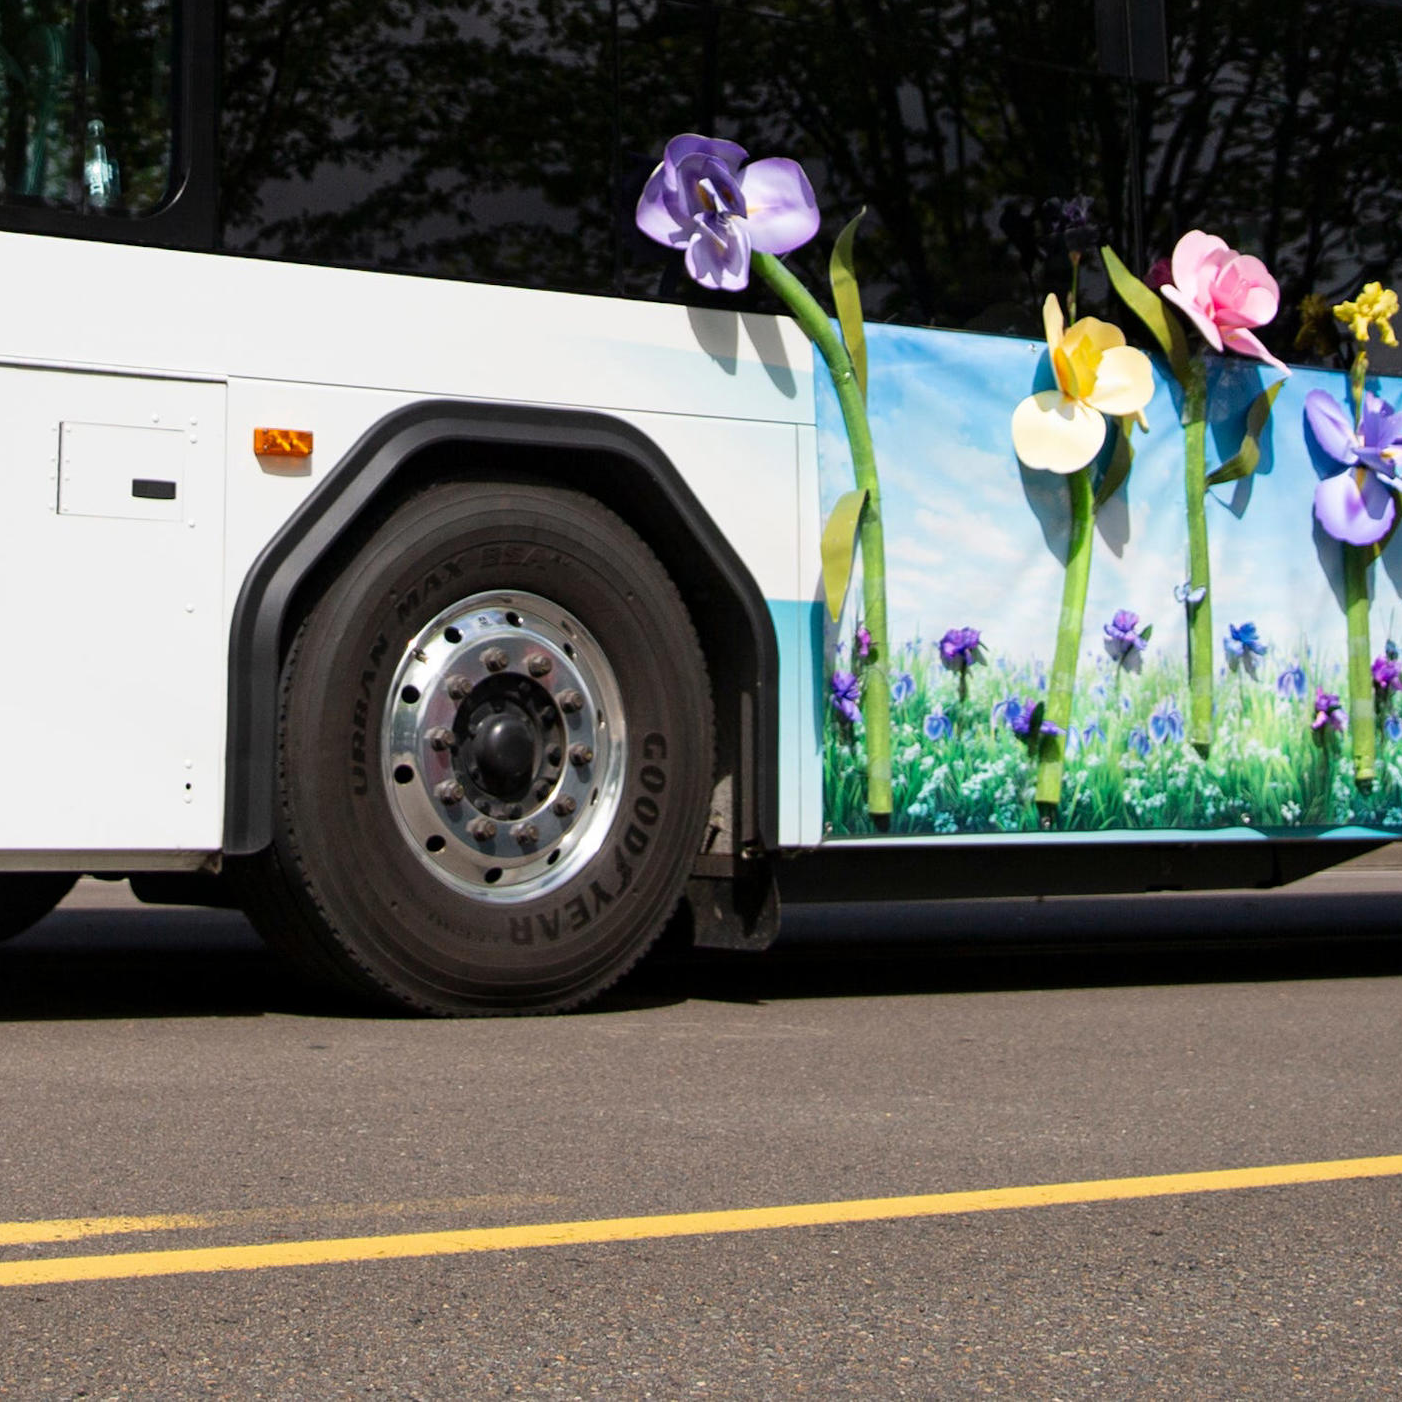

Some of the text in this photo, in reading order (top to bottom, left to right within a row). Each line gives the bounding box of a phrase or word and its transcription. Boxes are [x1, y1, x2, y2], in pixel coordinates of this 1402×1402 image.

[351, 632, 389, 797] URBAN
[394, 561, 467, 622] MAX
[509, 732, 668, 946] GOODYEAR
